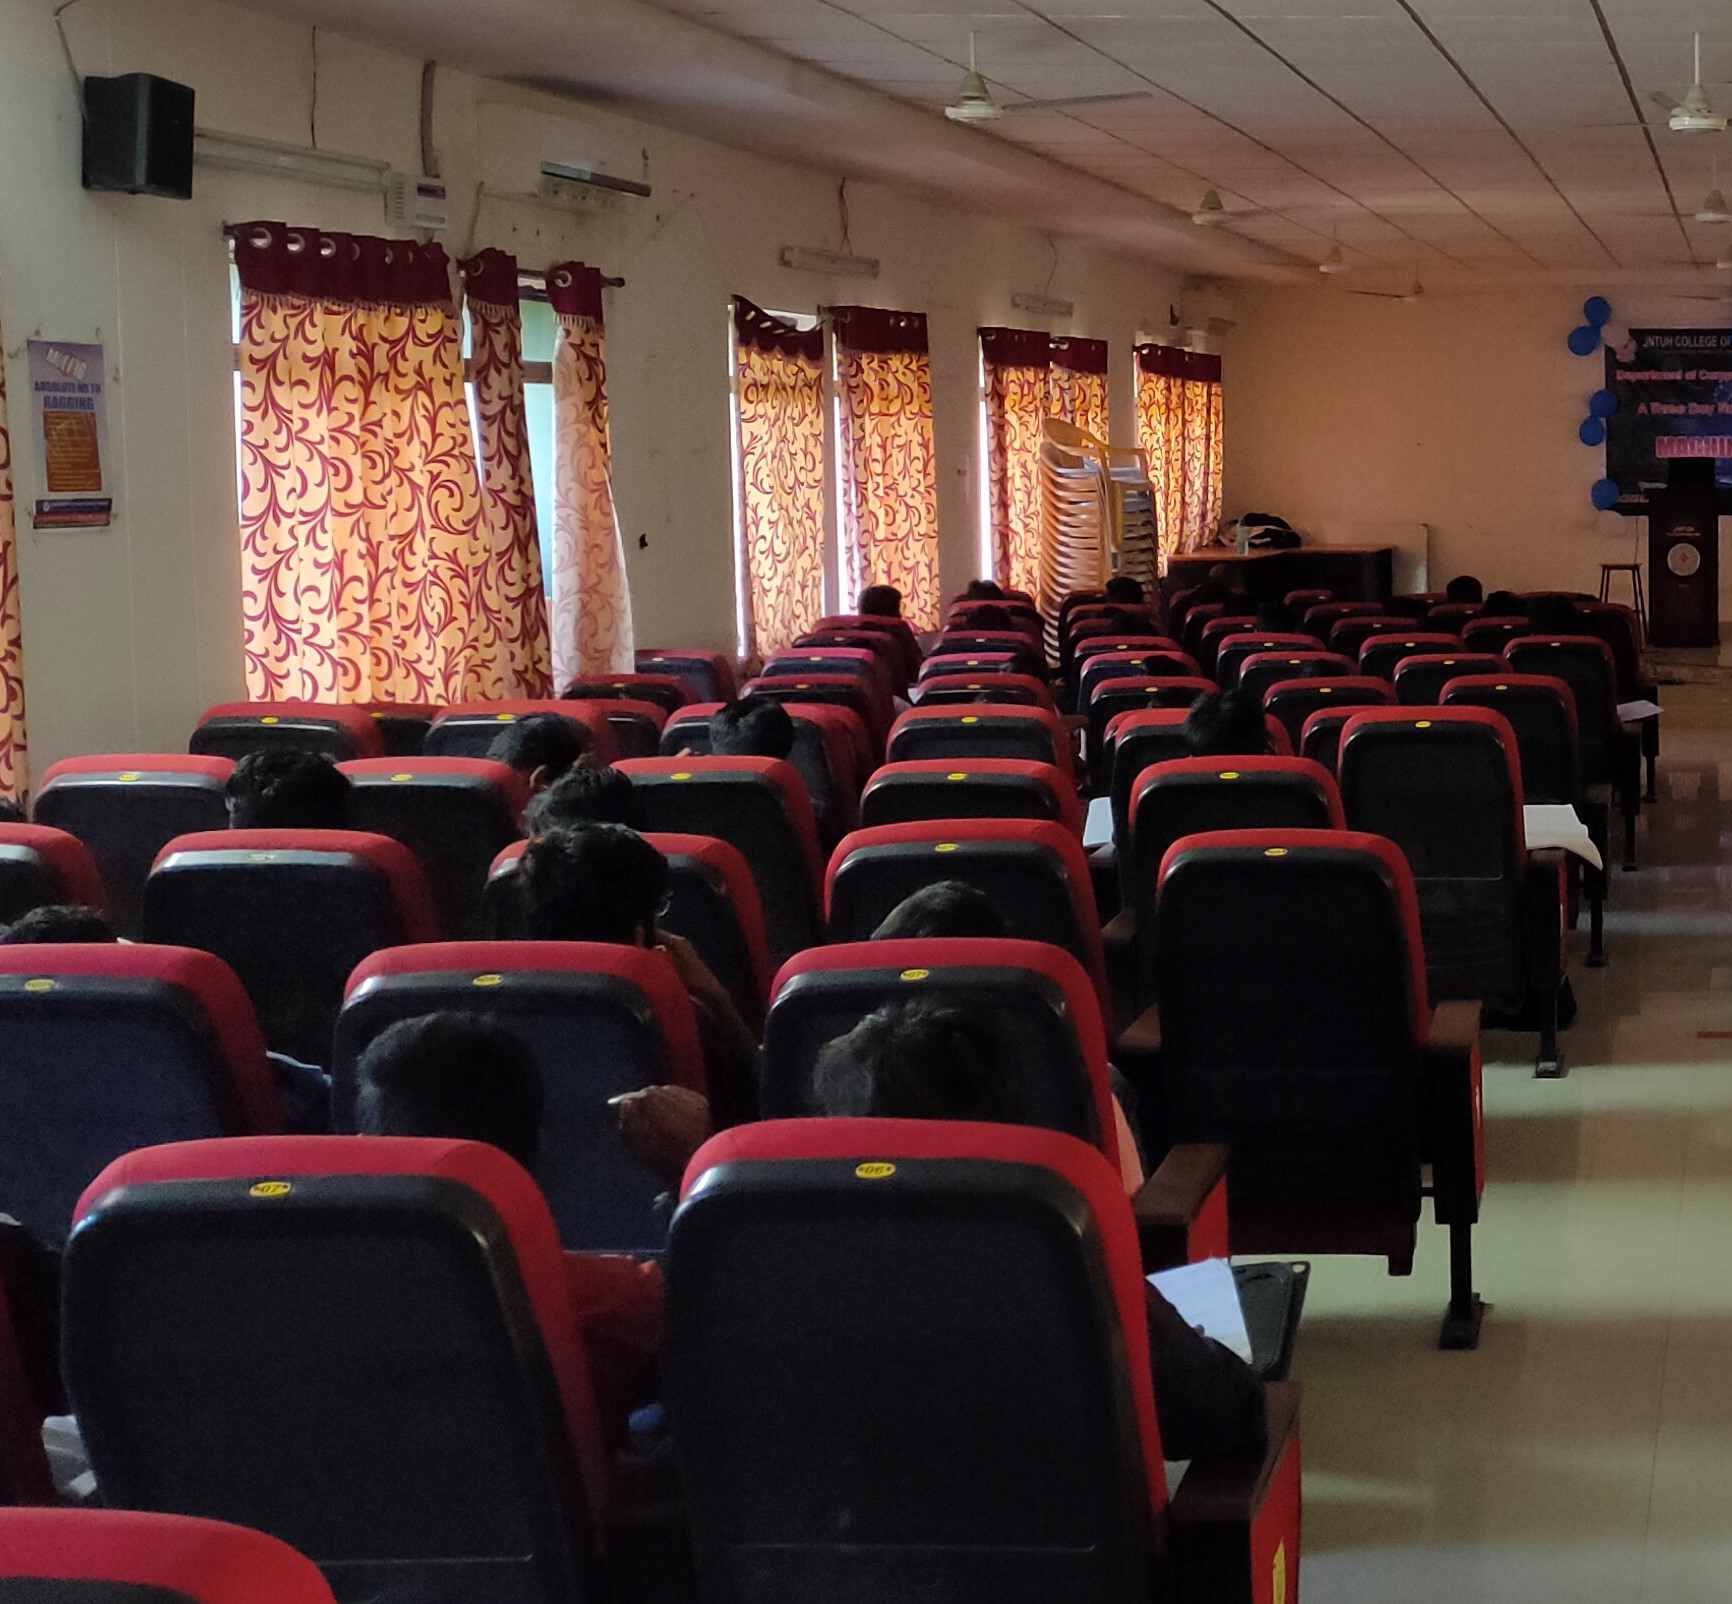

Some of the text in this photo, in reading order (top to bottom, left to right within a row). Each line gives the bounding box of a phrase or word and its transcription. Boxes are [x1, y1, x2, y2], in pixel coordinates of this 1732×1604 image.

[1643, 335, 1673, 347] JNTUH
[1674, 335, 1718, 347] COLLEGE
[77, 383, 90, 394] NO
[91, 383, 102, 395] TO
[43, 395, 95, 410] RAGGING
[865, 1165, 884, 1175] 06
[261, 1184, 281, 1194] 07
